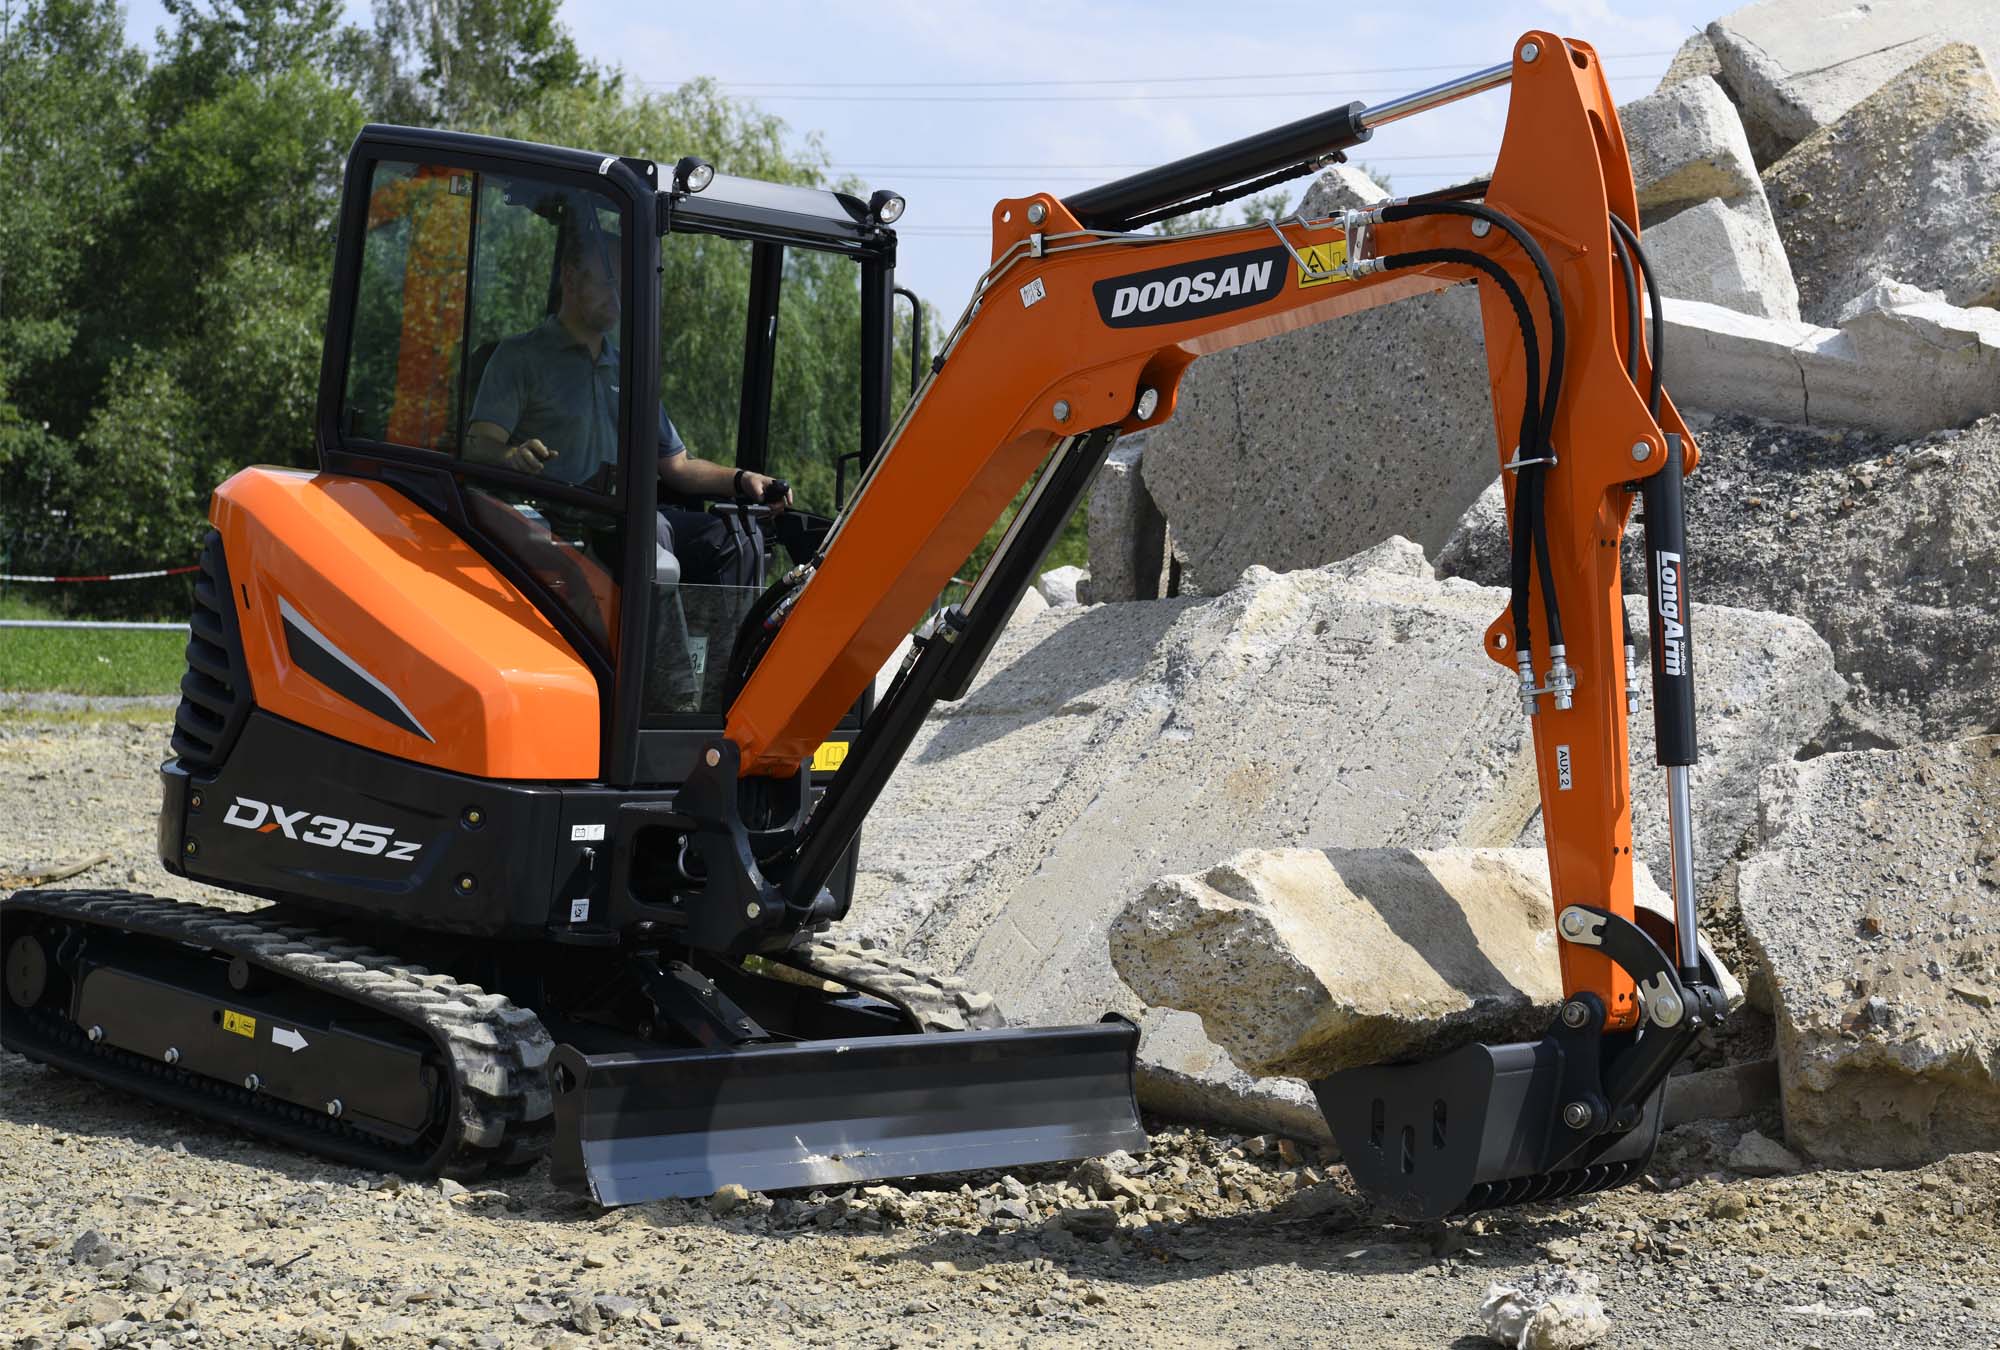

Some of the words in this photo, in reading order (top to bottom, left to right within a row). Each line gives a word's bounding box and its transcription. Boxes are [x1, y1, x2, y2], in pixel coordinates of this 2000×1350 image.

[1111, 260, 1273, 318] DOOSAN
[1656, 551, 1684, 676] LongArm
[1559, 750, 1569, 776] AUX
[1561, 778, 1570, 786] 2
